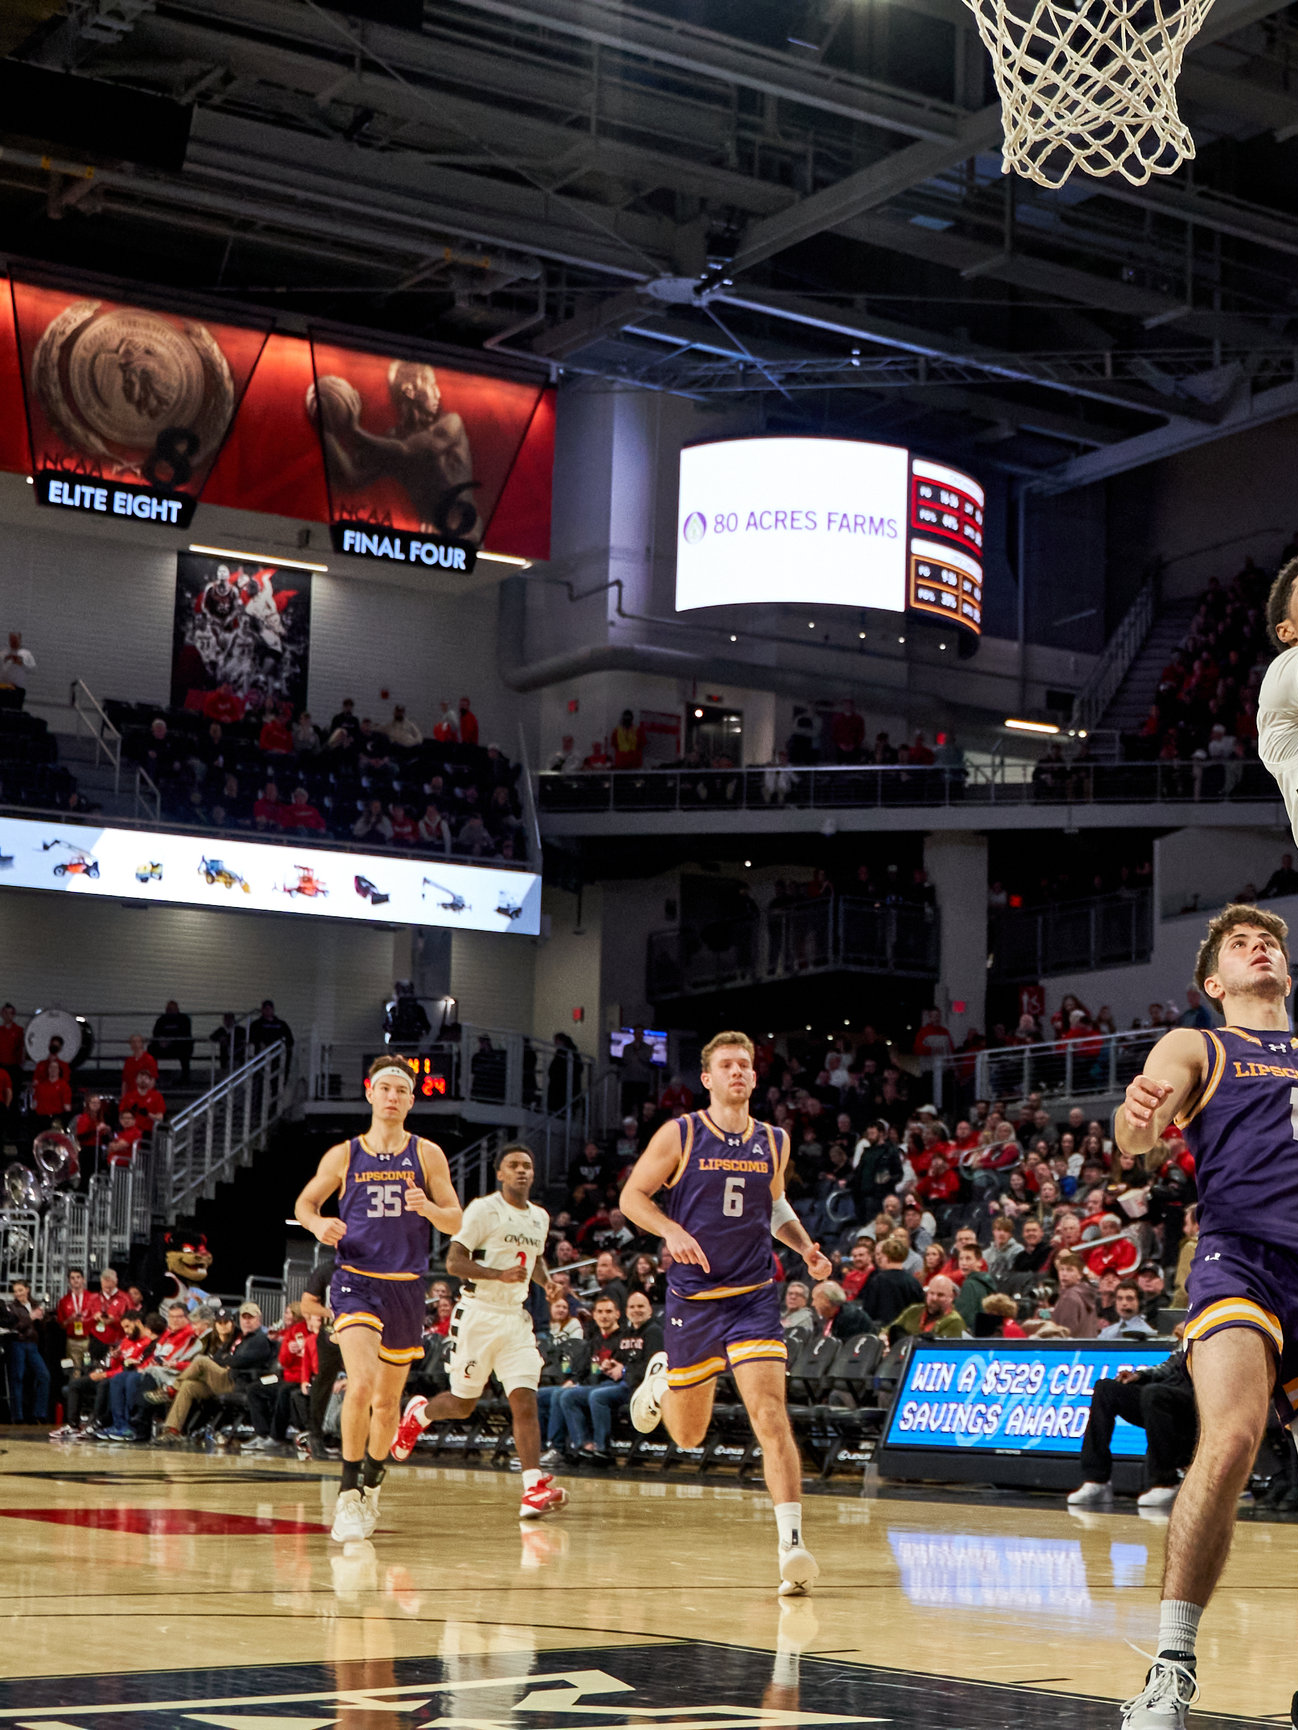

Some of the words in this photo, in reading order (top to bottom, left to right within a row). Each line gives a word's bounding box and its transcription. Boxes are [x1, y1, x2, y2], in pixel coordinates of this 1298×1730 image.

[48, 479, 109, 512] ELITE
[112, 490, 183, 524] EIGHT
[713, 512, 739, 534] 80
[745, 511, 818, 532] ACRES
[827, 511, 898, 540] FARMS
[342, 529, 406, 561] FINAL
[409, 540, 467, 571] FOUR
[422, 1075, 446, 1097] 24
[354, 1170, 416, 1183] LIPSCOMB
[698, 1158, 769, 1174] LIPSCOMB
[366, 1185, 402, 1218] 35
[722, 1176, 746, 1218] 6
[910, 1363, 957, 1393] WIN
[957, 1363, 978, 1393] A
[981, 1360, 1047, 1395] $529
[899, 1400, 1003, 1435] SAVINGS
[1004, 1404, 1090, 1439] AWARD
